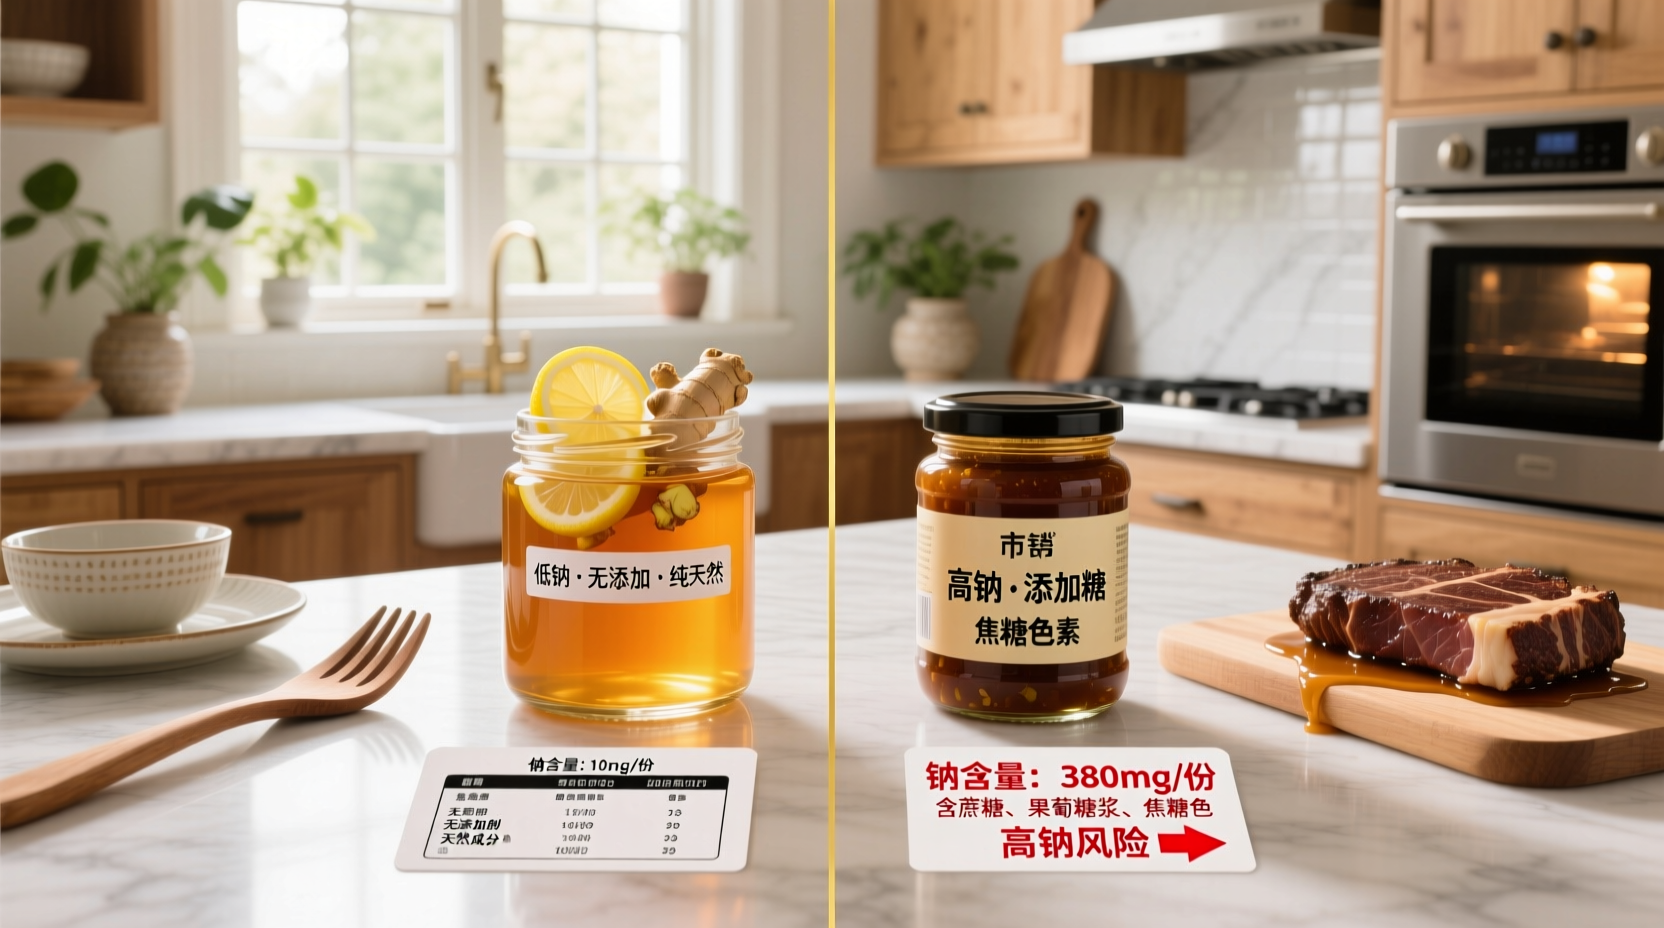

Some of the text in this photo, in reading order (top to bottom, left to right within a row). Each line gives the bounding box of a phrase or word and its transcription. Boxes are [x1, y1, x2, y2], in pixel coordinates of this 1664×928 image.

[975, 616, 1080, 647] 焦糖色素
[1001, 826, 1150, 858] 高钠风险
